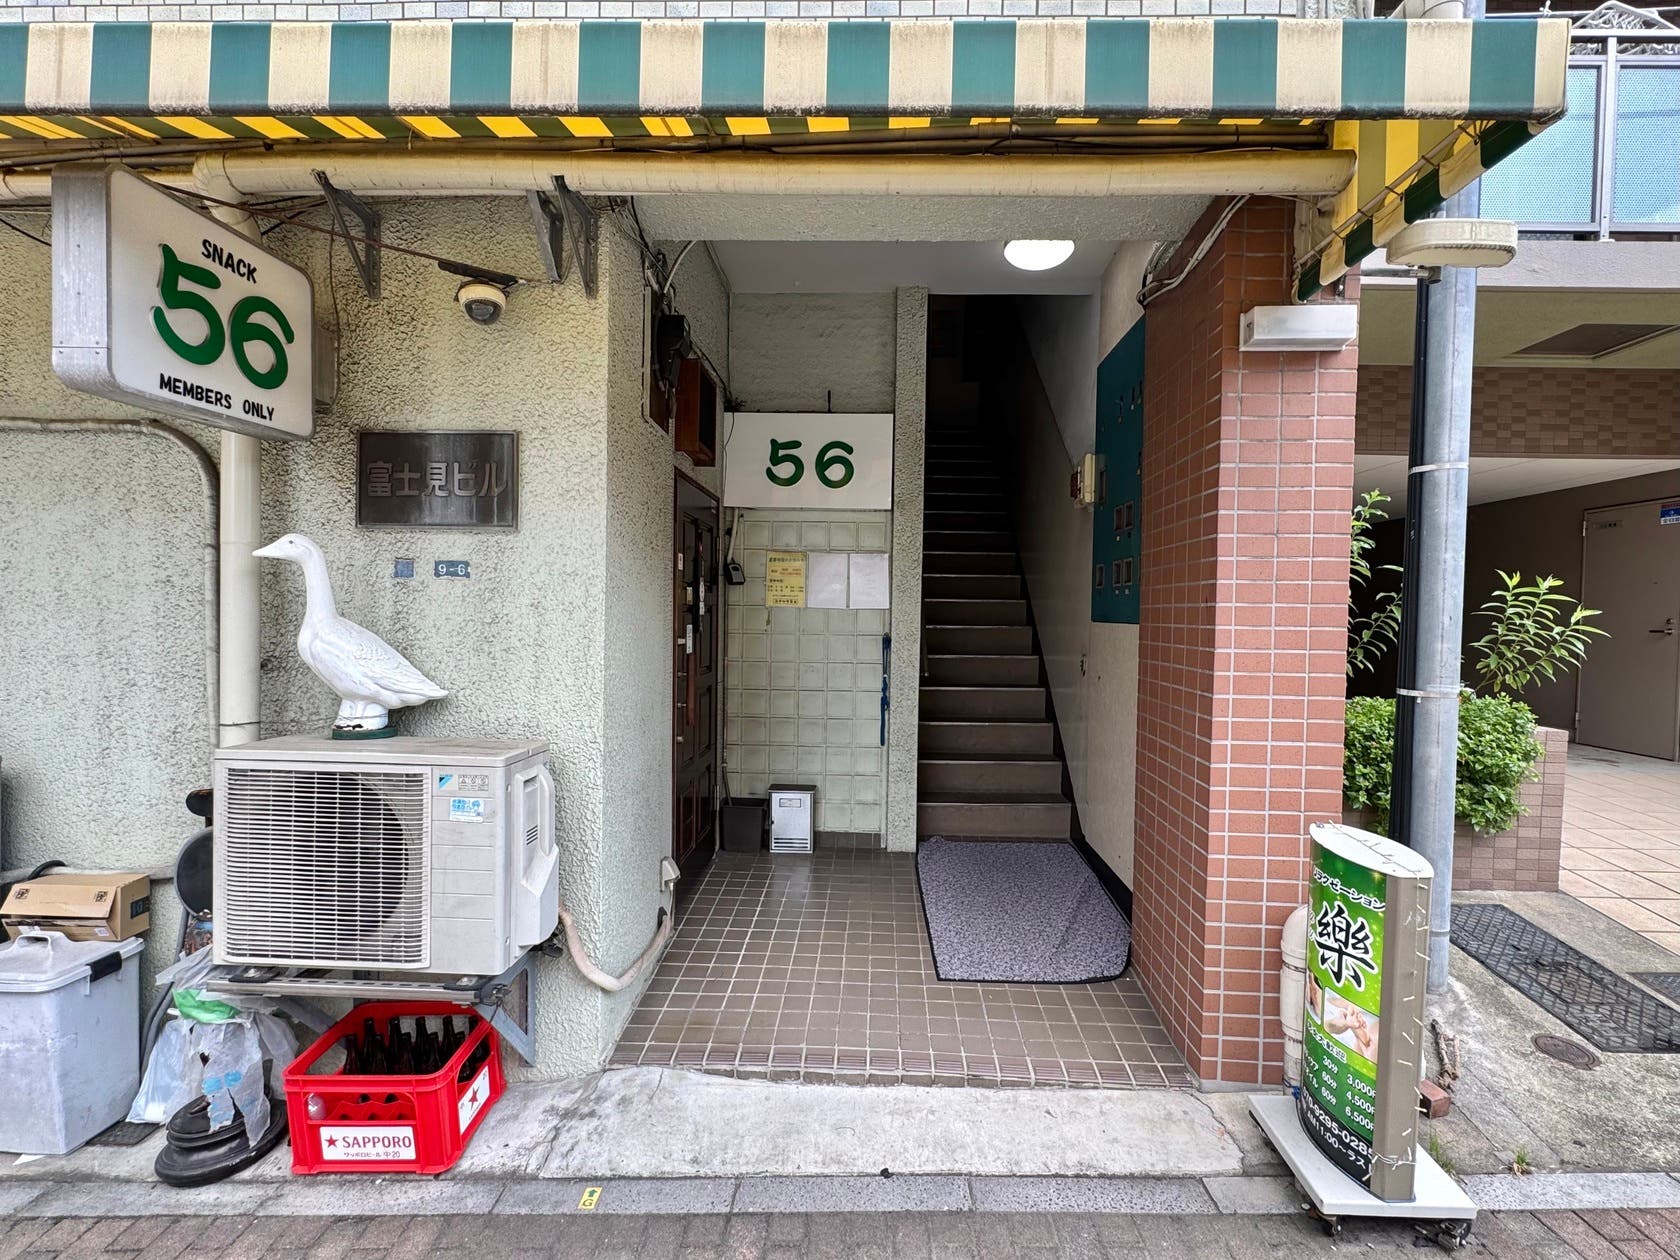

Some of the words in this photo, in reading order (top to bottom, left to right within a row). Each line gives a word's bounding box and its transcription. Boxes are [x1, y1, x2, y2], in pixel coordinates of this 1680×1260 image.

[201, 239, 257, 284] SNACK
[153, 243, 295, 390] 56
[159, 373, 232, 409] MEMBERS
[243, 399, 275, 421] ONLY
[367, 459, 507, 497] 富士見ビル
[765, 438, 854, 489] 56
[438, 563, 466, 576] 9-6
[1316, 901, 1377, 989] 樂
[342, 1135, 412, 1149] SAPPORO
[582, 1198, 594, 1207] G
